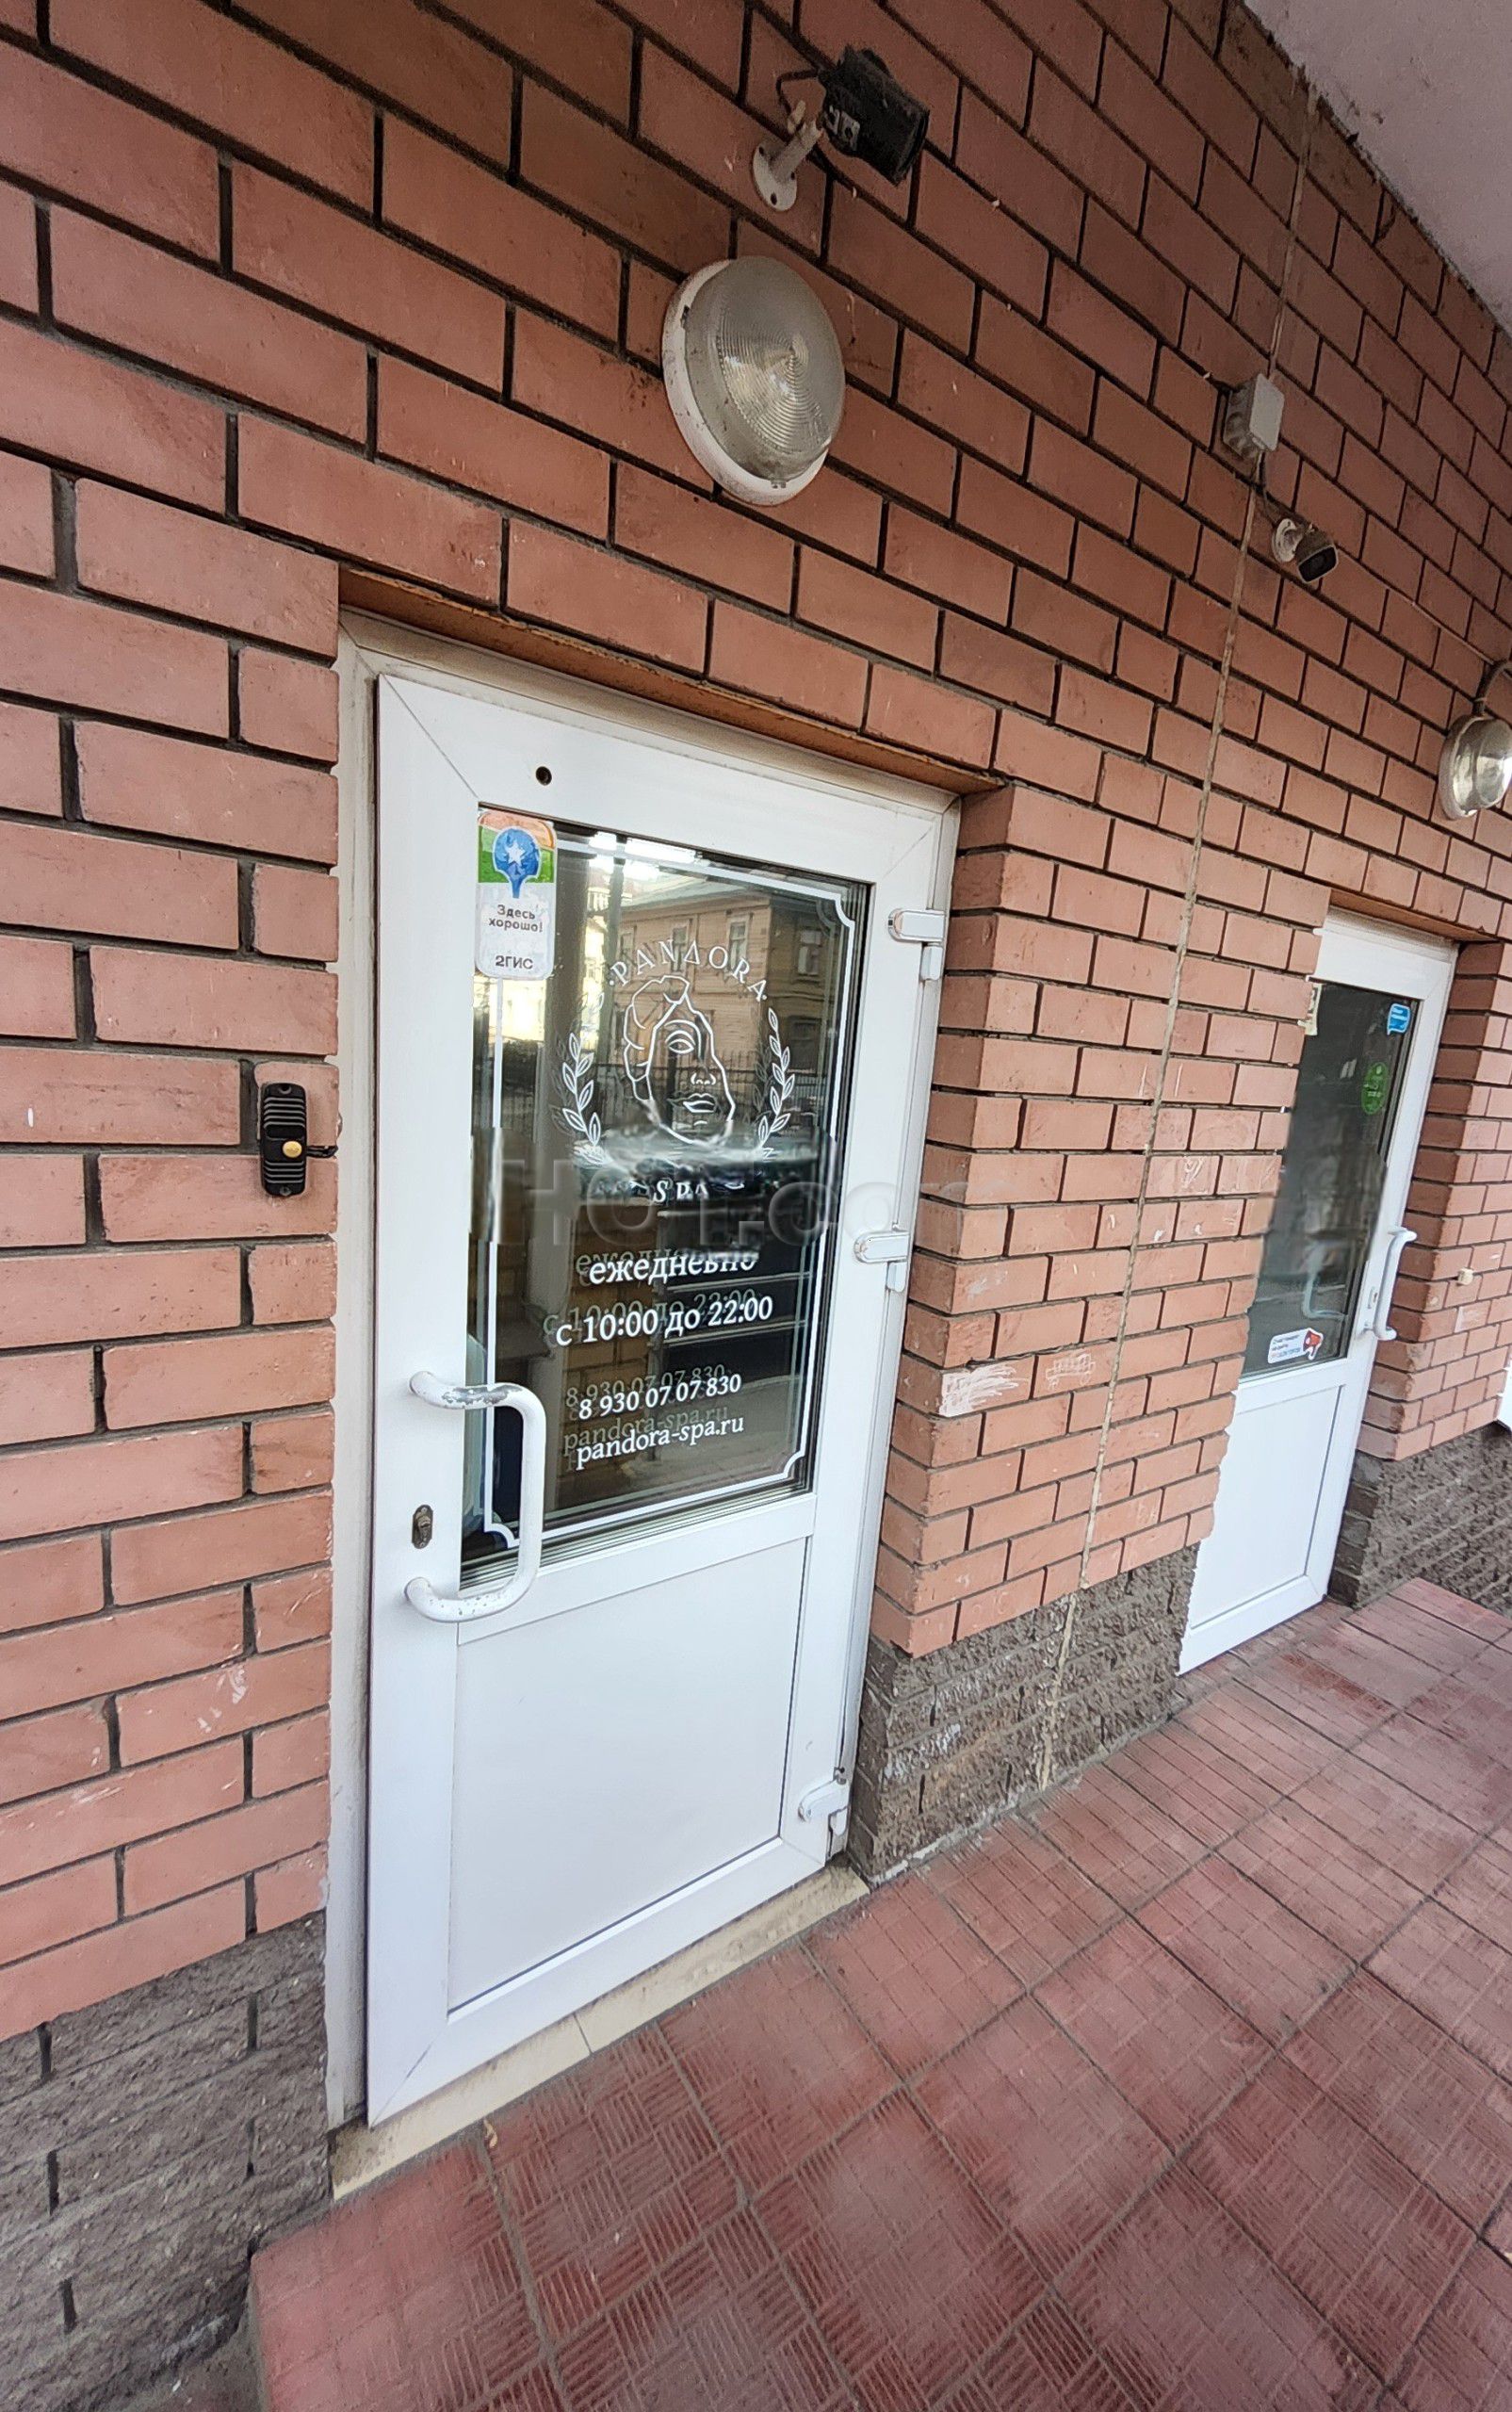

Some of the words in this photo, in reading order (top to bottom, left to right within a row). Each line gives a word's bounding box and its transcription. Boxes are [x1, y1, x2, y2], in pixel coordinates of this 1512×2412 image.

[489, 918, 543, 933] хорошо!
[497, 904, 535, 920] Здесь
[496, 954, 533, 970] 2ГИС
[582, 1308, 658, 1344] 10:00
[664, 1308, 701, 1339] до
[707, 1296, 773, 1327] 22:00
[578, 1398, 592, 1420] 8
[599, 1391, 640, 1417] 930
[645, 1385, 673, 1408] 07
[675, 1379, 702, 1402] 07
[706, 1374, 741, 1397] 830
[576, 1416, 744, 1471] pandora-spa.ru
